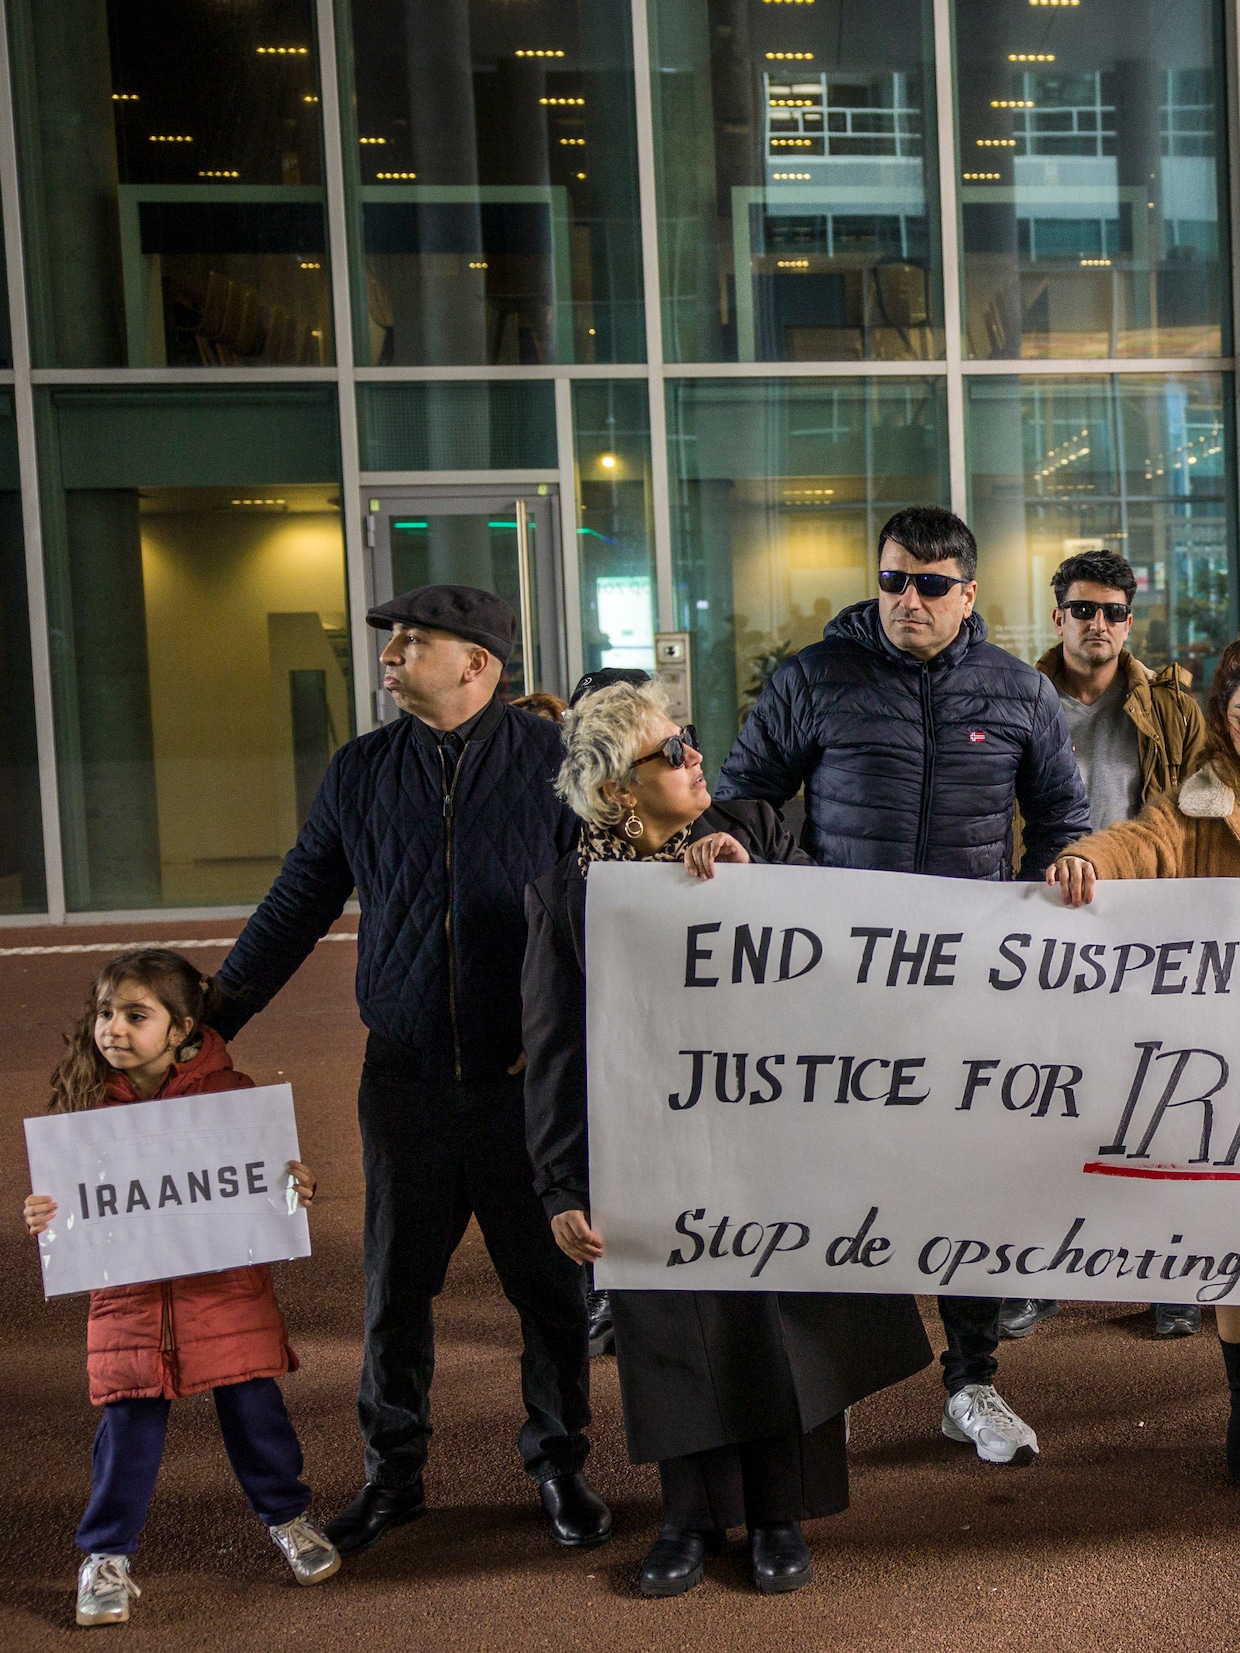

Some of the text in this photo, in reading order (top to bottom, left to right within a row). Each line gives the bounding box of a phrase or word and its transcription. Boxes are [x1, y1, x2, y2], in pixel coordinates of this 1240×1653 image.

[684, 922, 824, 988] END
[850, 926, 965, 988] THE
[668, 1050, 932, 1111] JUSTICE
[954, 1059, 1084, 1118] FOR
[78, 1161, 268, 1220] IRAANSE
[666, 1208, 811, 1279] Stop
[825, 1206, 897, 1268] de
